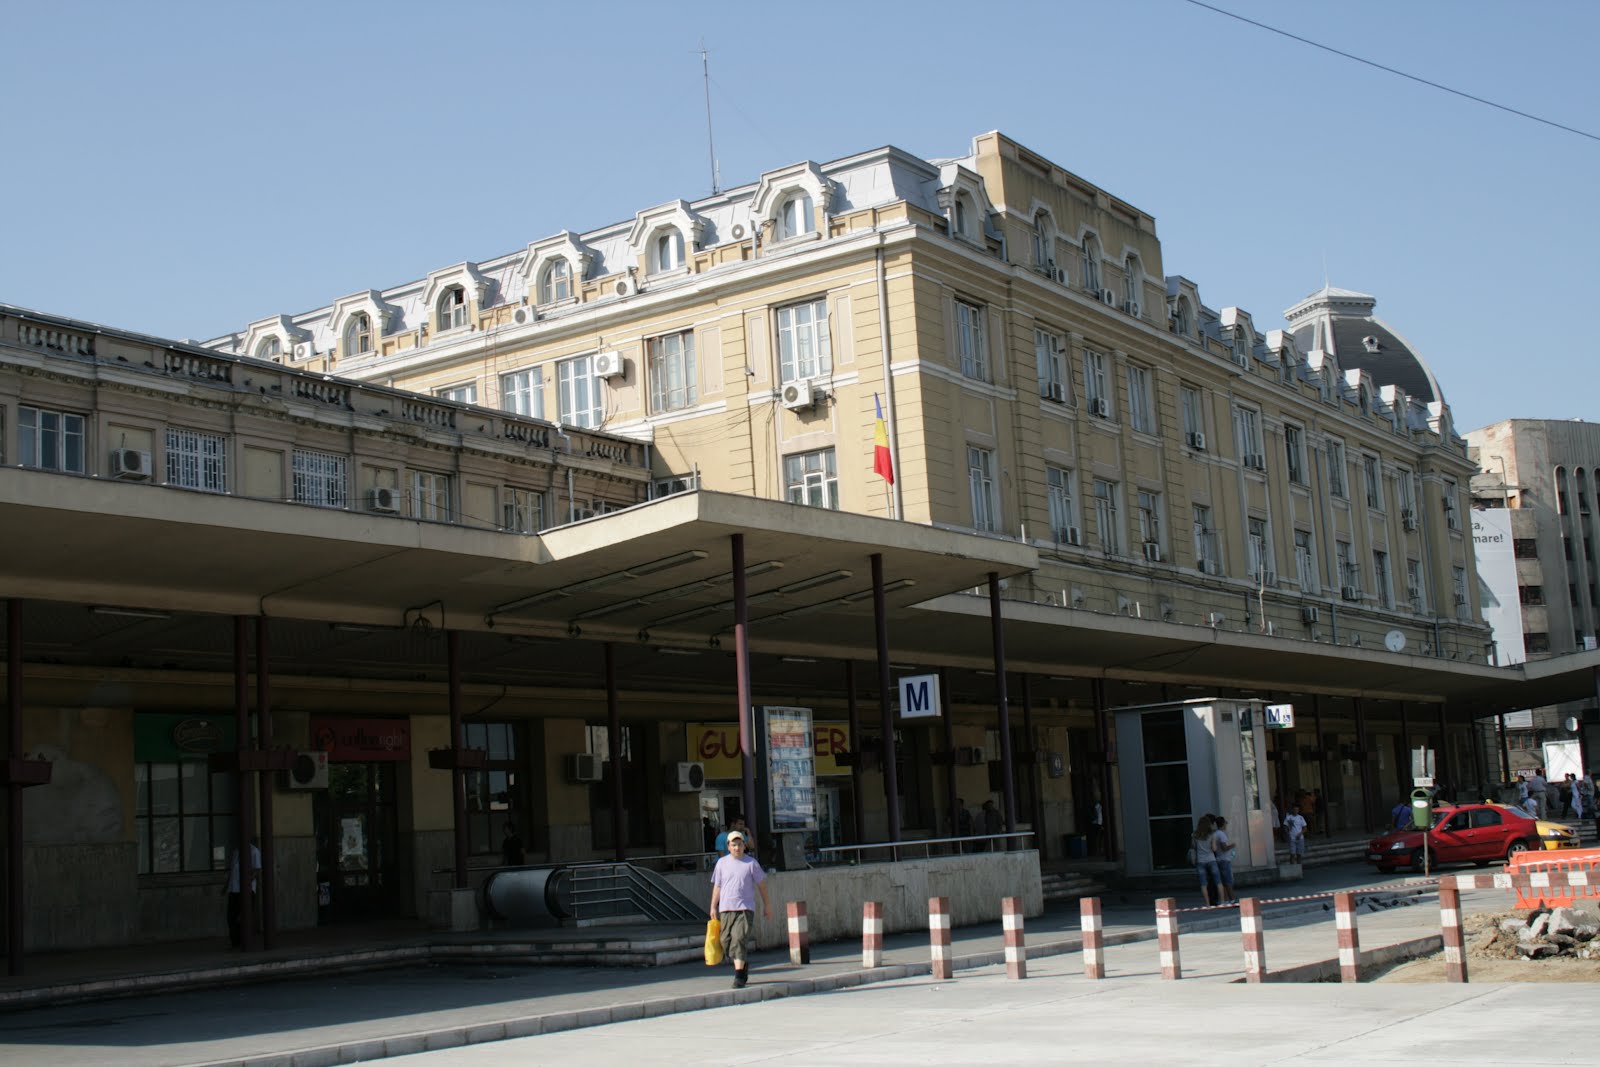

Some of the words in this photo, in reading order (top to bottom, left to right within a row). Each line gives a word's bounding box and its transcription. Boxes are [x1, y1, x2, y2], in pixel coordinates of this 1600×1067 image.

[1473, 533, 1503, 543] mare!
[905, 682, 929, 712] M
[1268, 708, 1280, 722] M
